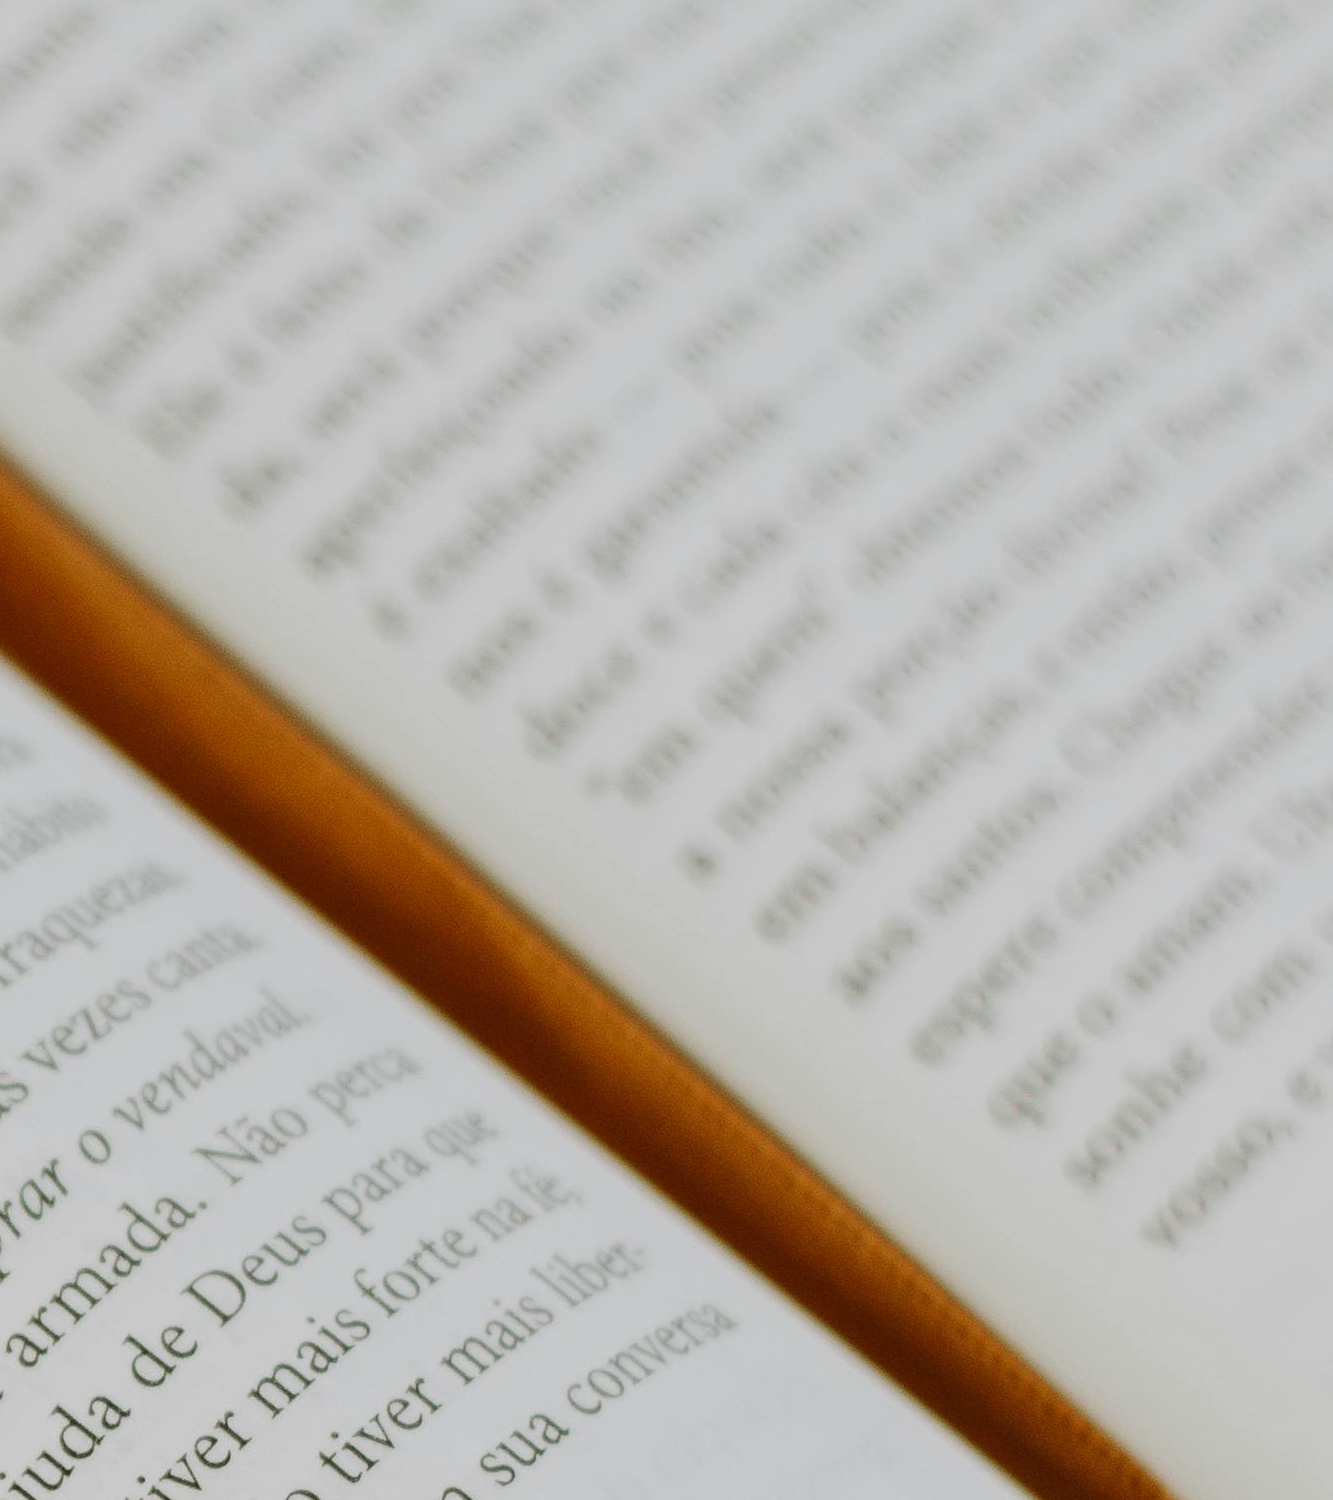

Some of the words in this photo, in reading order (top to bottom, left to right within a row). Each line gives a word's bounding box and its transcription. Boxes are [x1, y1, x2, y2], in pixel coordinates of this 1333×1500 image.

[17, 978, 153, 1073] vezes
[76, 1127, 113, 1166] o
[110, 987, 313, 1133] vendaval.
[4, 1196, 207, 1369] armada.
[190, 1107, 310, 1187] Não
[123, 1324, 198, 1389] de
[179, 1215, 328, 1328] Deus
[319, 1146, 431, 1237] para
[246, 1308, 372, 1419] mais
[352, 1228, 479, 1319] forte
[317, 1376, 443, 1485] tiver
[438, 1295, 555, 1386] mais
[478, 1412, 571, 1487] sua
